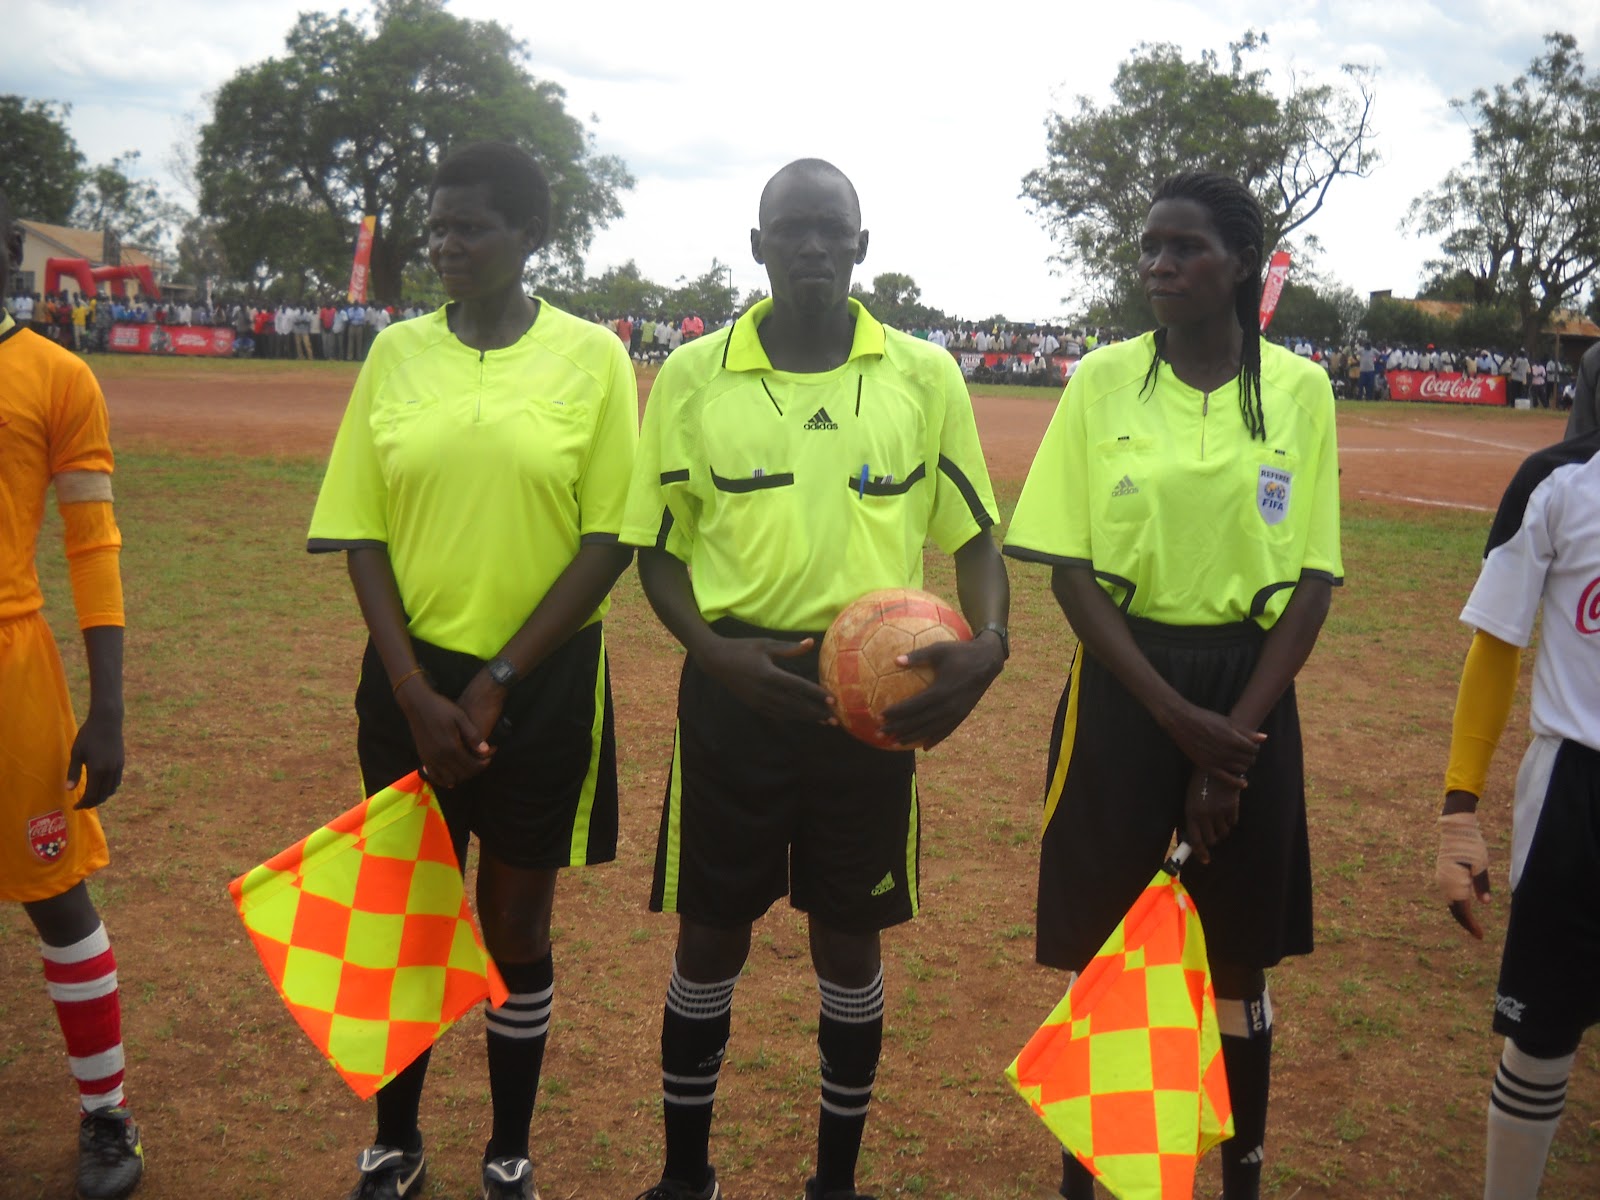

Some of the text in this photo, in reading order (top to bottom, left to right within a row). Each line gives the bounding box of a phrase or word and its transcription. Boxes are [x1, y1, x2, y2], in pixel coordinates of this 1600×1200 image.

[803, 421, 838, 431] adidas
[1261, 469, 1290, 484] REFEREE
[1111, 485, 1139, 498] adidas
[1262, 498, 1284, 511] FIFA
